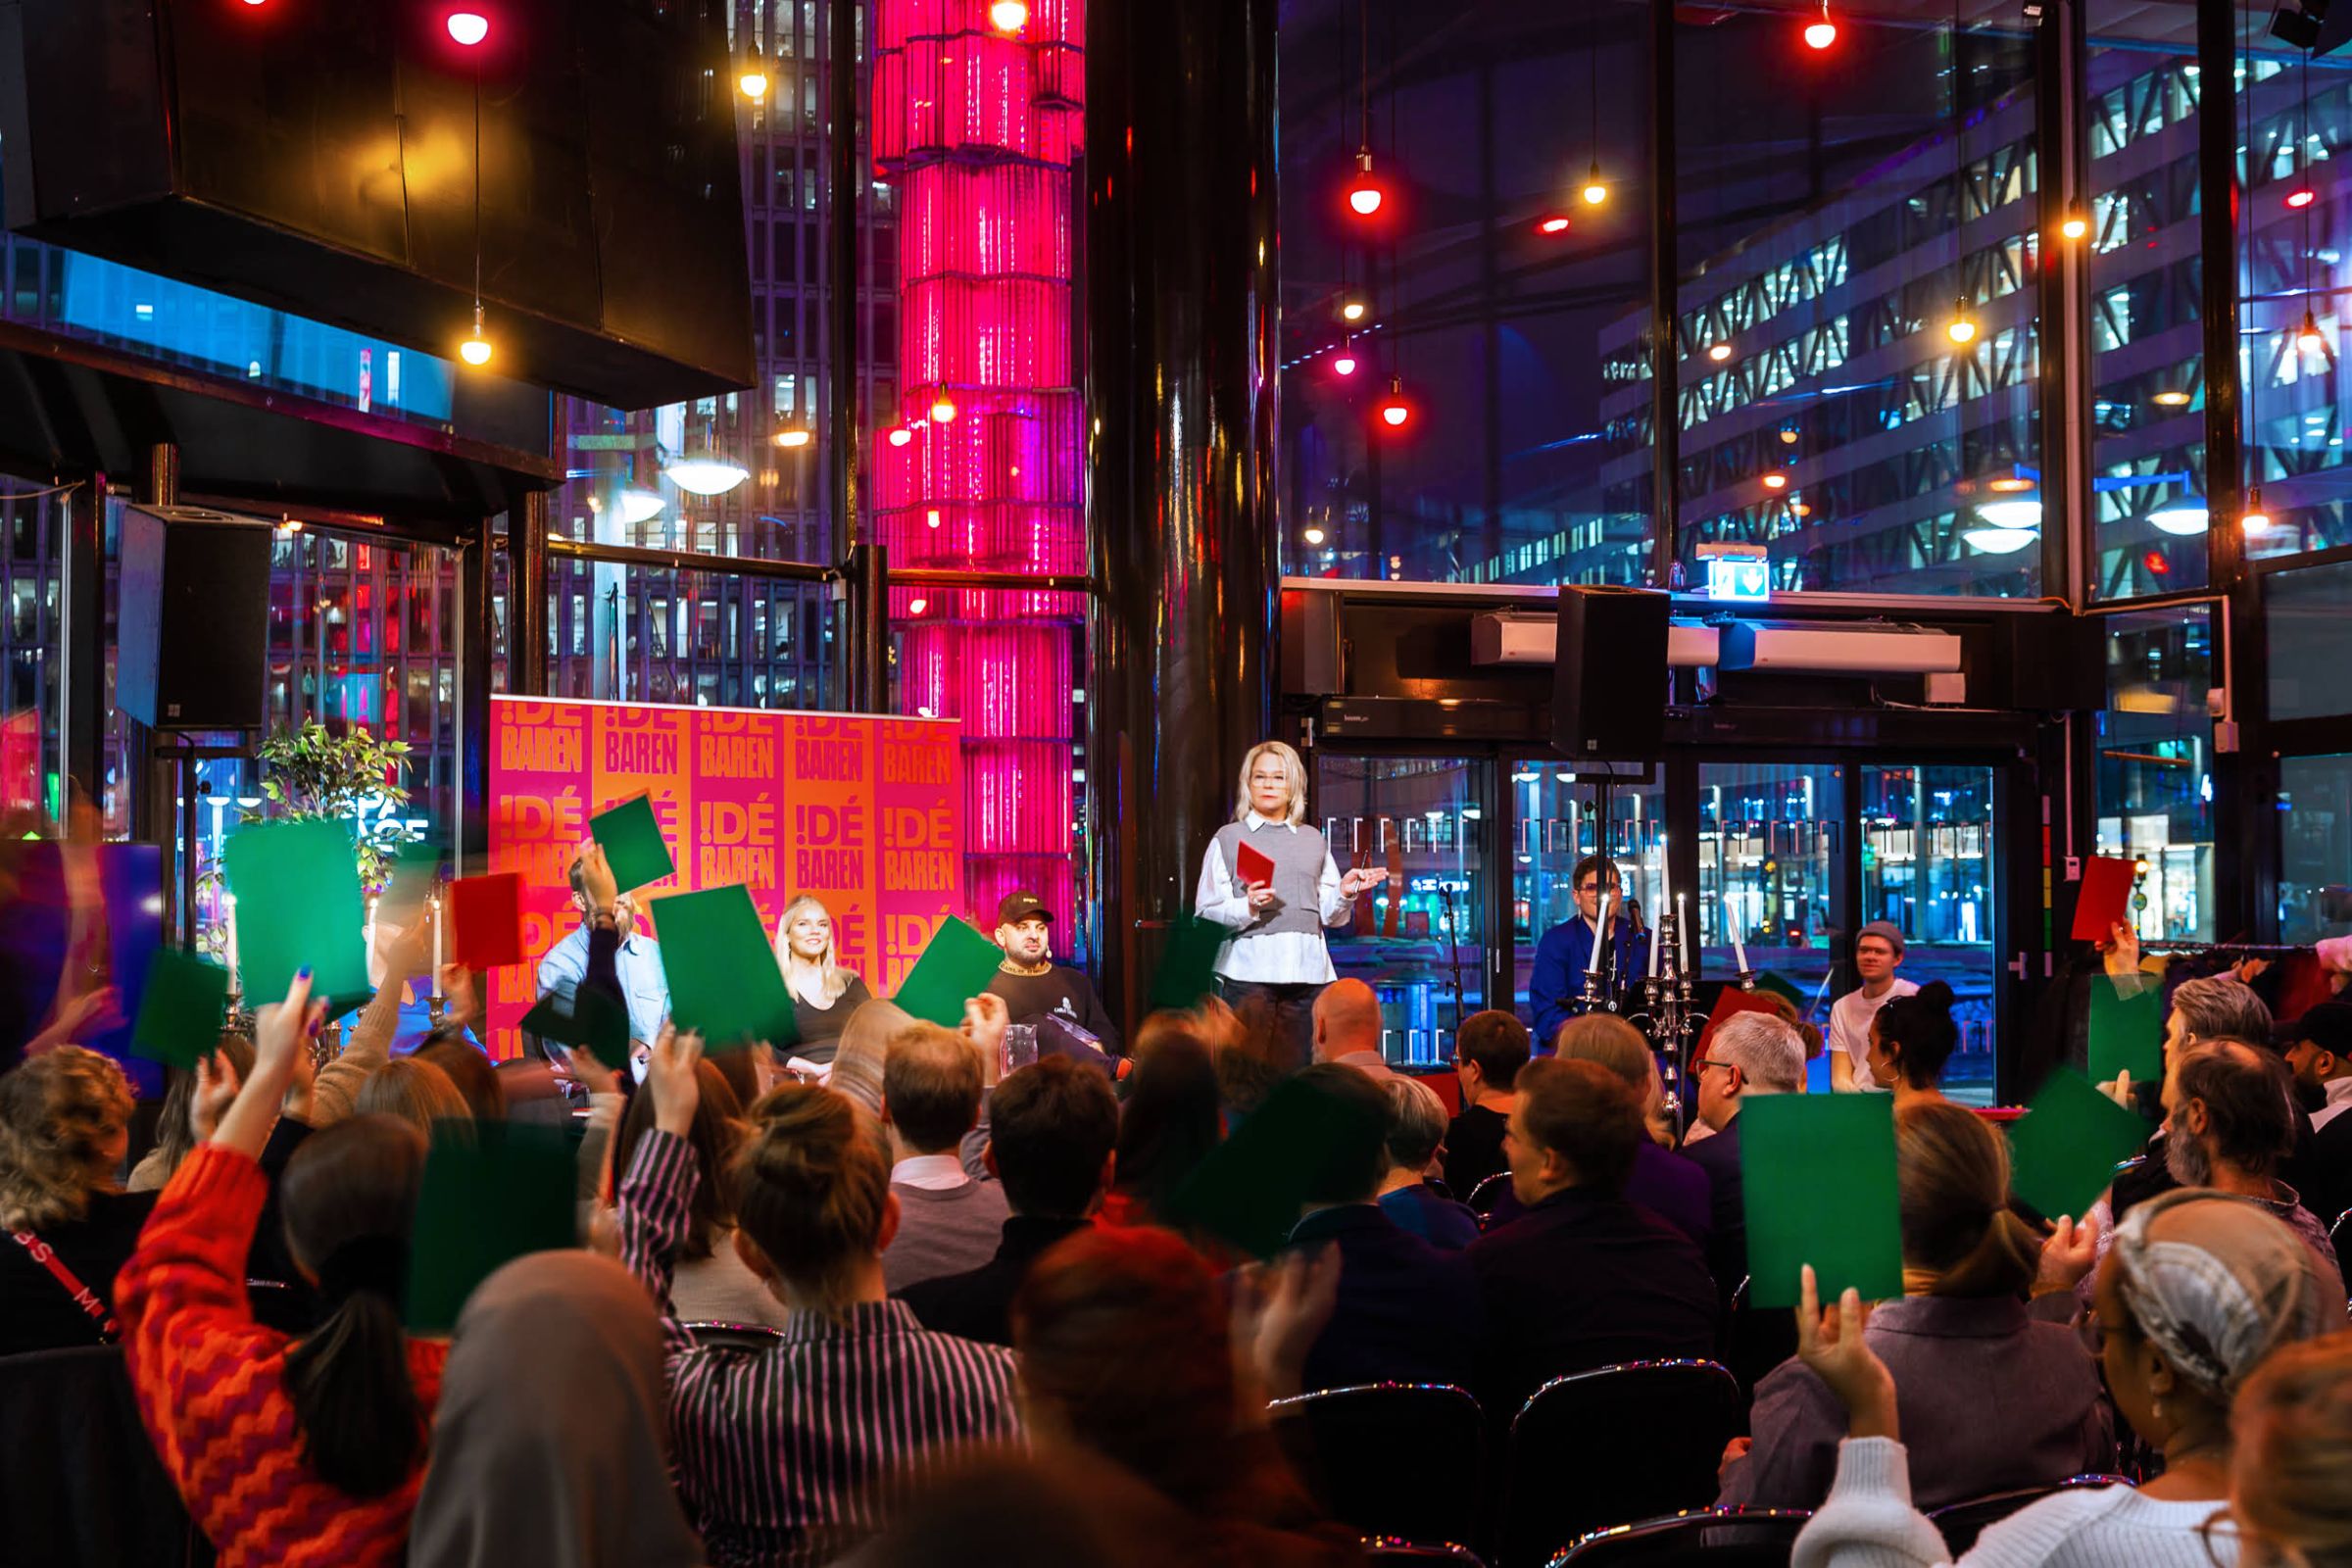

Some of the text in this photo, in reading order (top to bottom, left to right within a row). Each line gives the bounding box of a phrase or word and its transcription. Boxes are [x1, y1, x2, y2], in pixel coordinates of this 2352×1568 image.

[500, 725, 582, 772] BAREN
[606, 731, 677, 774] BAREN
[700, 735, 774, 779] BAREN
[796, 739, 863, 782] BAREN
[883, 743, 953, 784] BAREN
[500, 785, 582, 842] !DÉ
[700, 792, 774, 845] !DÉ
[796, 795, 863, 847] !DÉ
[884, 799, 954, 848] !DÉ
[701, 846, 775, 890] BAREN
[797, 850, 864, 889] BAREN
[884, 851, 955, 890] BAREN
[517, 900, 581, 956] DÉ
